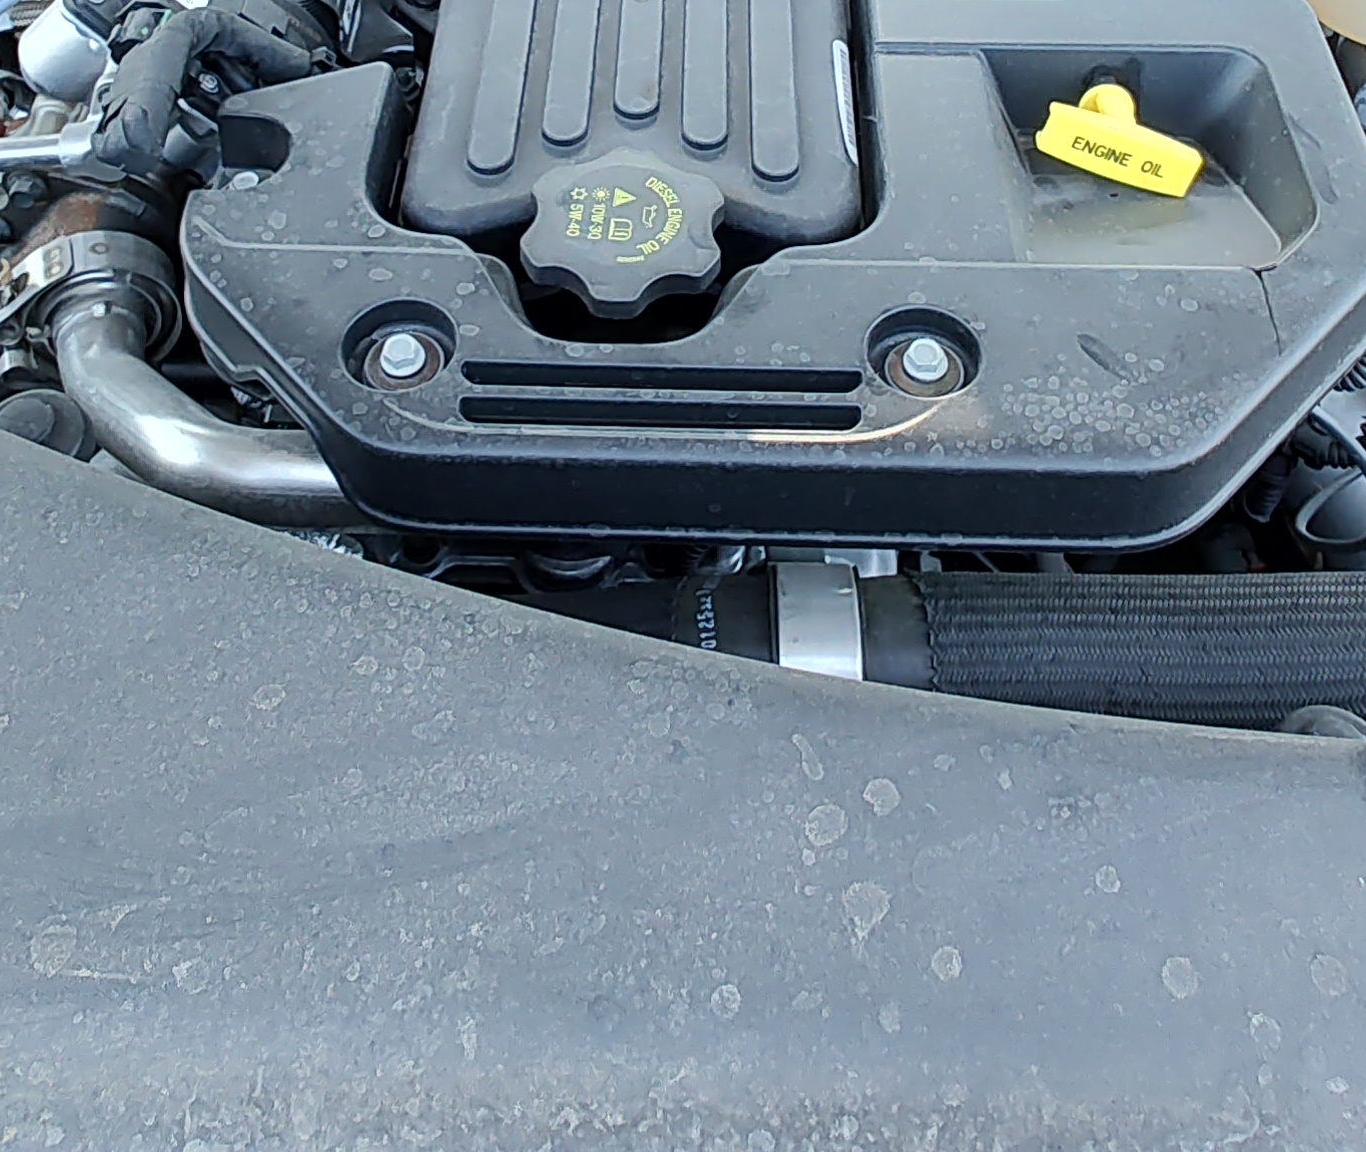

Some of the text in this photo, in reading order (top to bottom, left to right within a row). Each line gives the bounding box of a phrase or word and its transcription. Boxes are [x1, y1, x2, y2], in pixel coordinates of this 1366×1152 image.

[1071, 135, 1165, 179] ENGINE OIL
[566, 203, 584, 237] 5W-40
[587, 203, 607, 240] 10W-30
[635, 176, 683, 256] DIESEL ENGINE OIL
